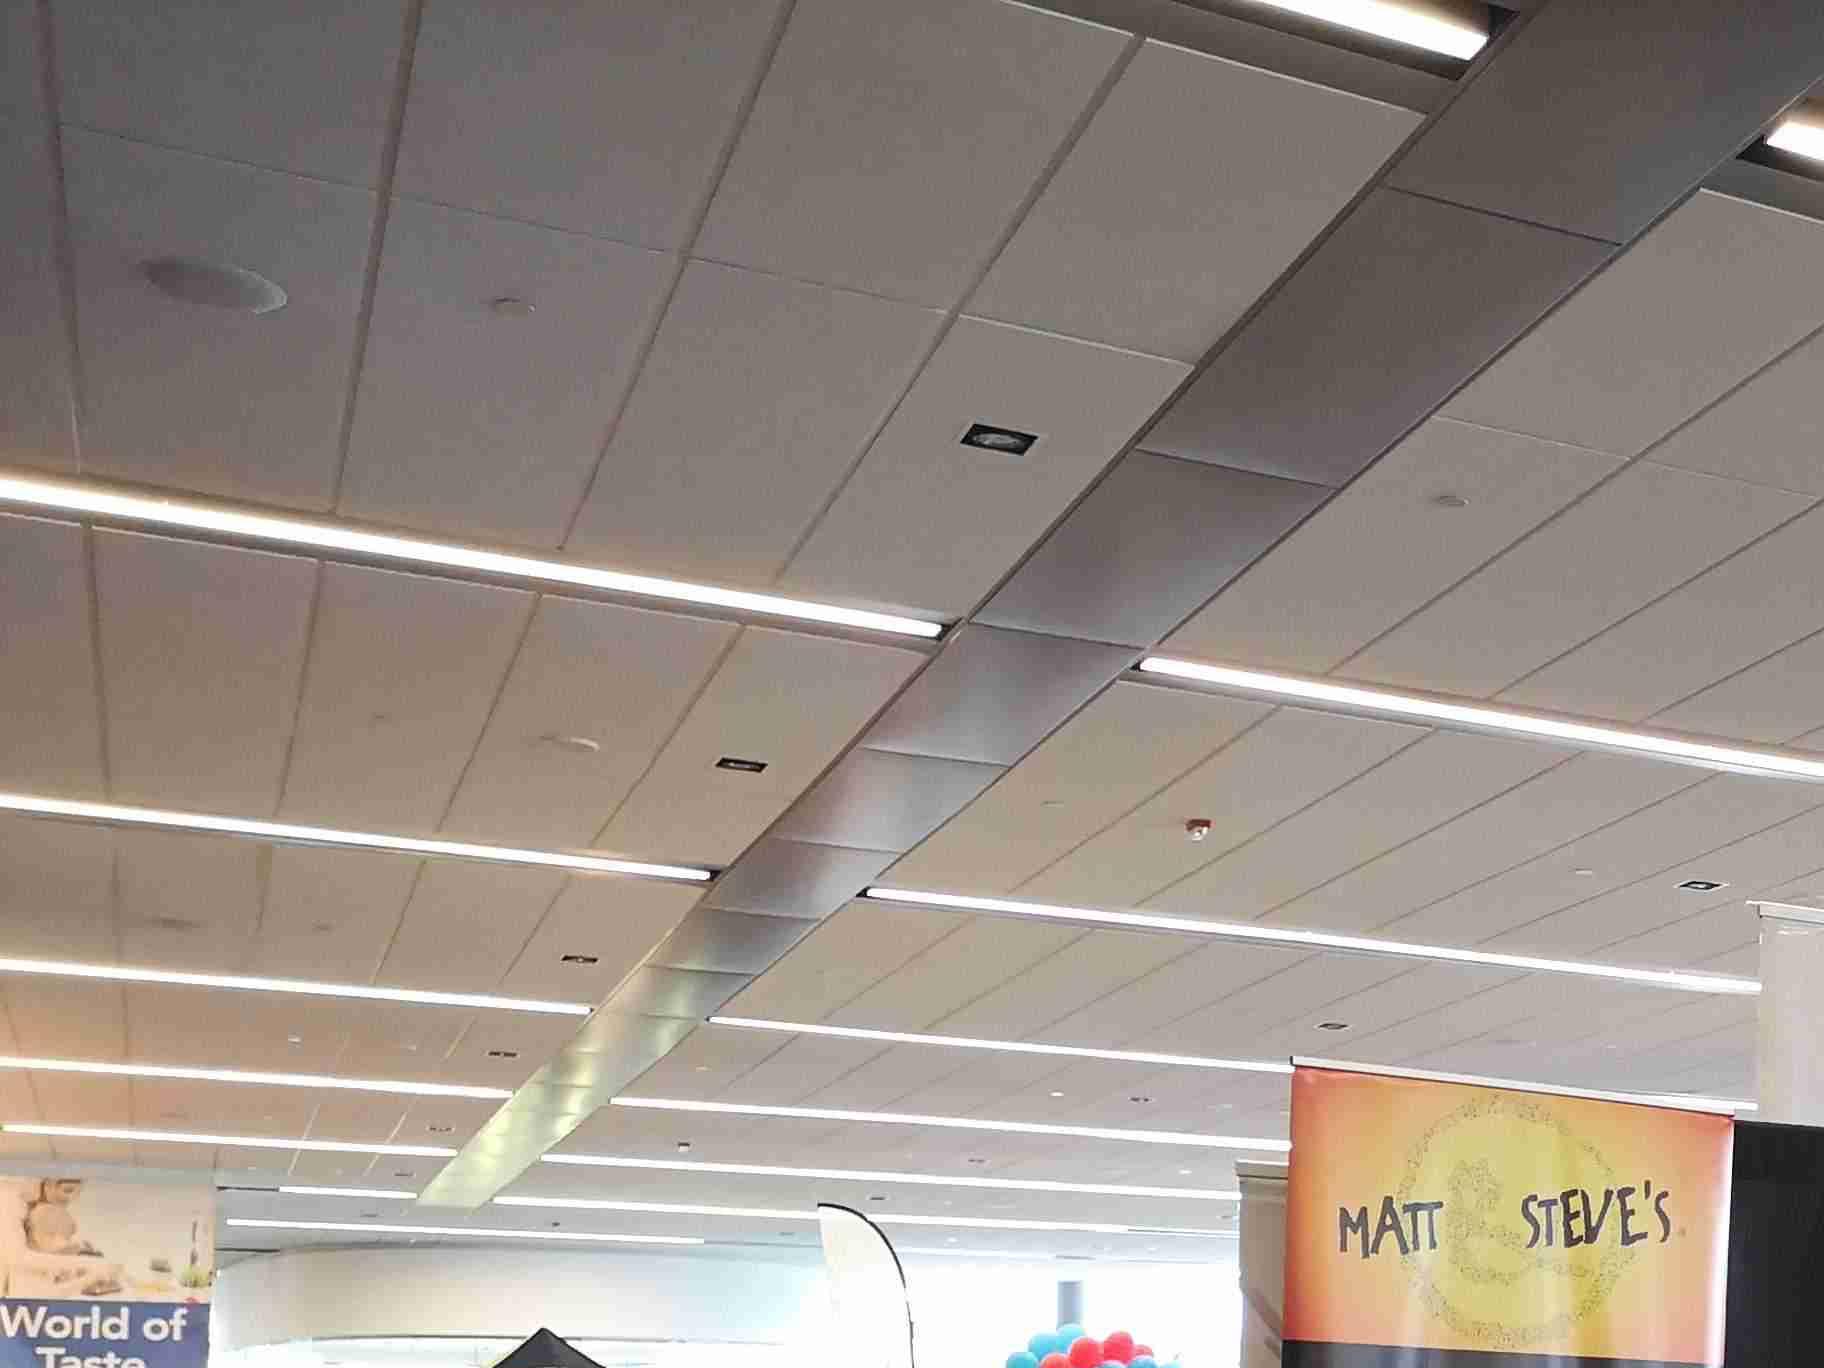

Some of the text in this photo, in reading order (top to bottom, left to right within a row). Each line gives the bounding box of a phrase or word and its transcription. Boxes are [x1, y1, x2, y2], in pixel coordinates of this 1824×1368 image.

[1338, 1195, 1445, 1260] MATT
[1521, 1180, 1672, 1249] STEVE'S
[0, 1305, 189, 1342] World of
